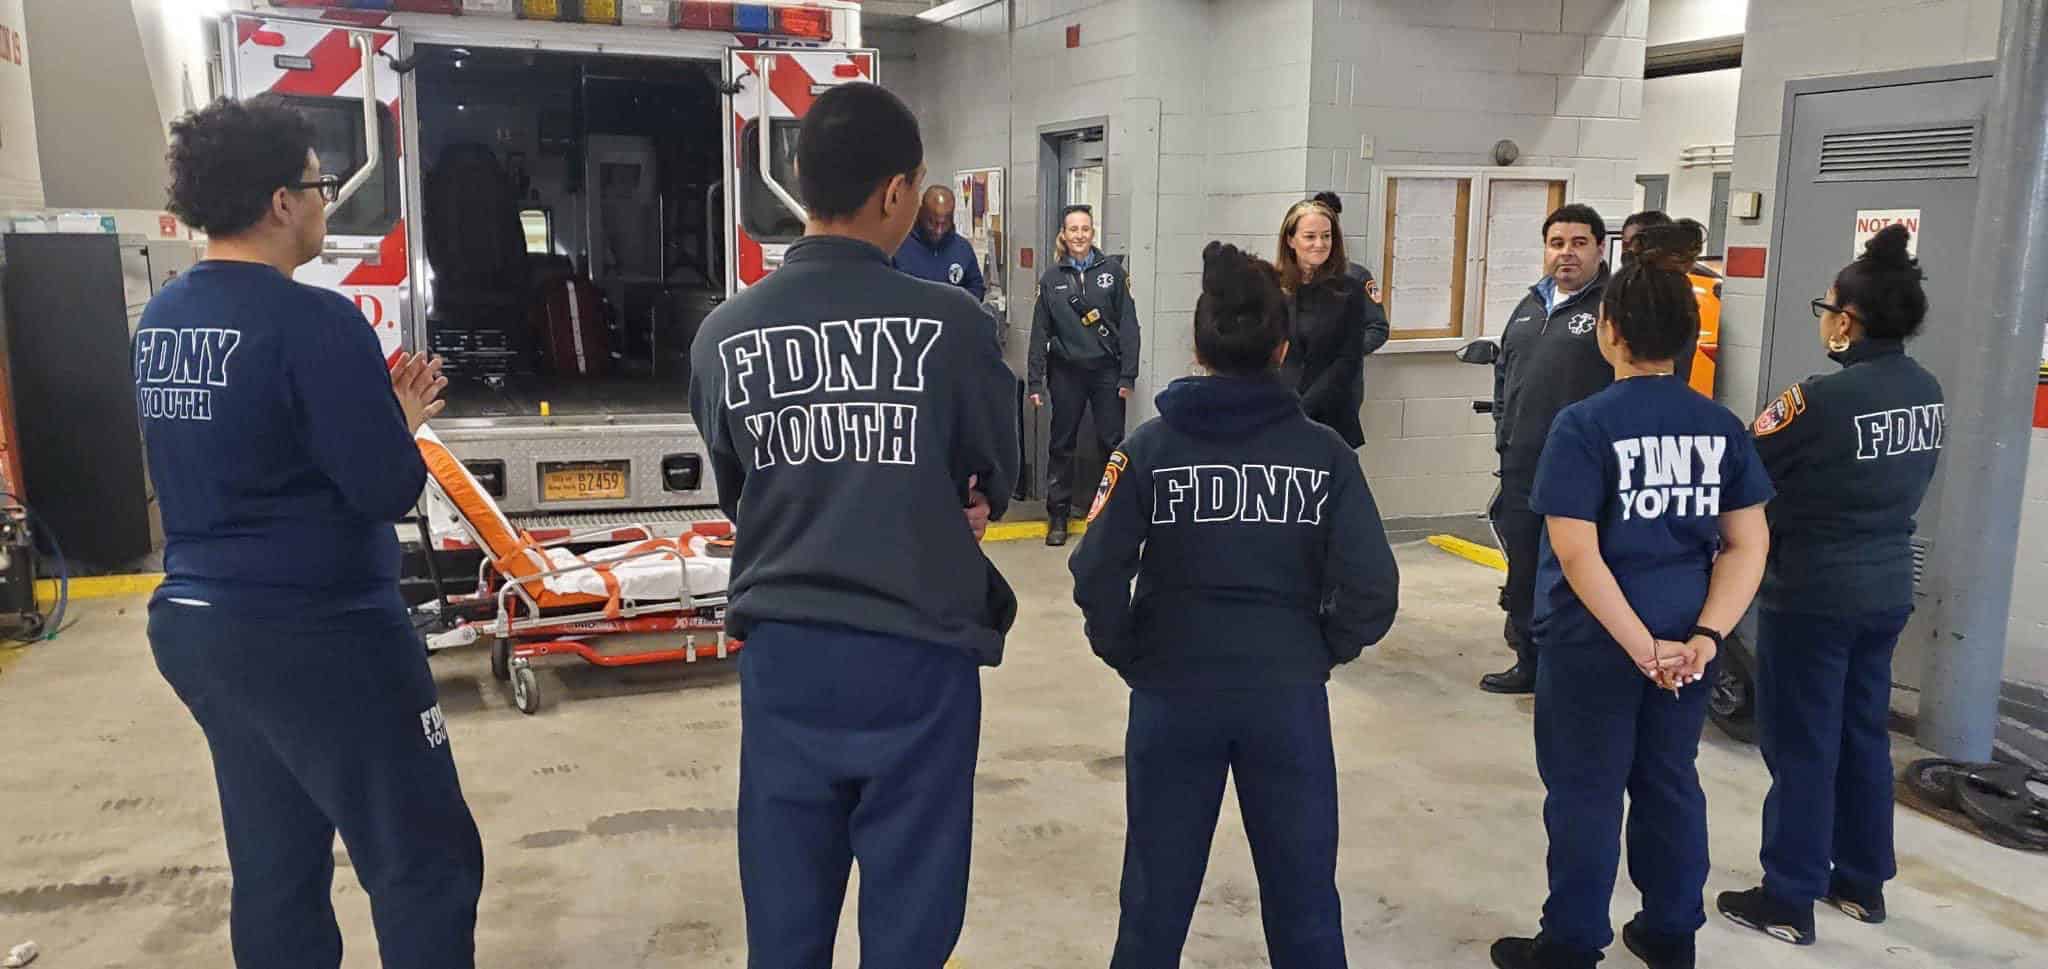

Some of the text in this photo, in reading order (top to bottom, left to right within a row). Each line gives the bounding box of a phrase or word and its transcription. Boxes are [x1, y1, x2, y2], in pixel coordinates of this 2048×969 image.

[1858, 218, 1891, 232] NOT
[136, 328, 240, 386] FDNY
[718, 317, 943, 410] FDNY
[141, 387, 212, 420] YOUTH
[745, 403, 917, 469] YOUTH
[1152, 464, 1330, 524] FDNY
[420, 702, 443, 736] FD
[426, 728, 448, 748] YOU
